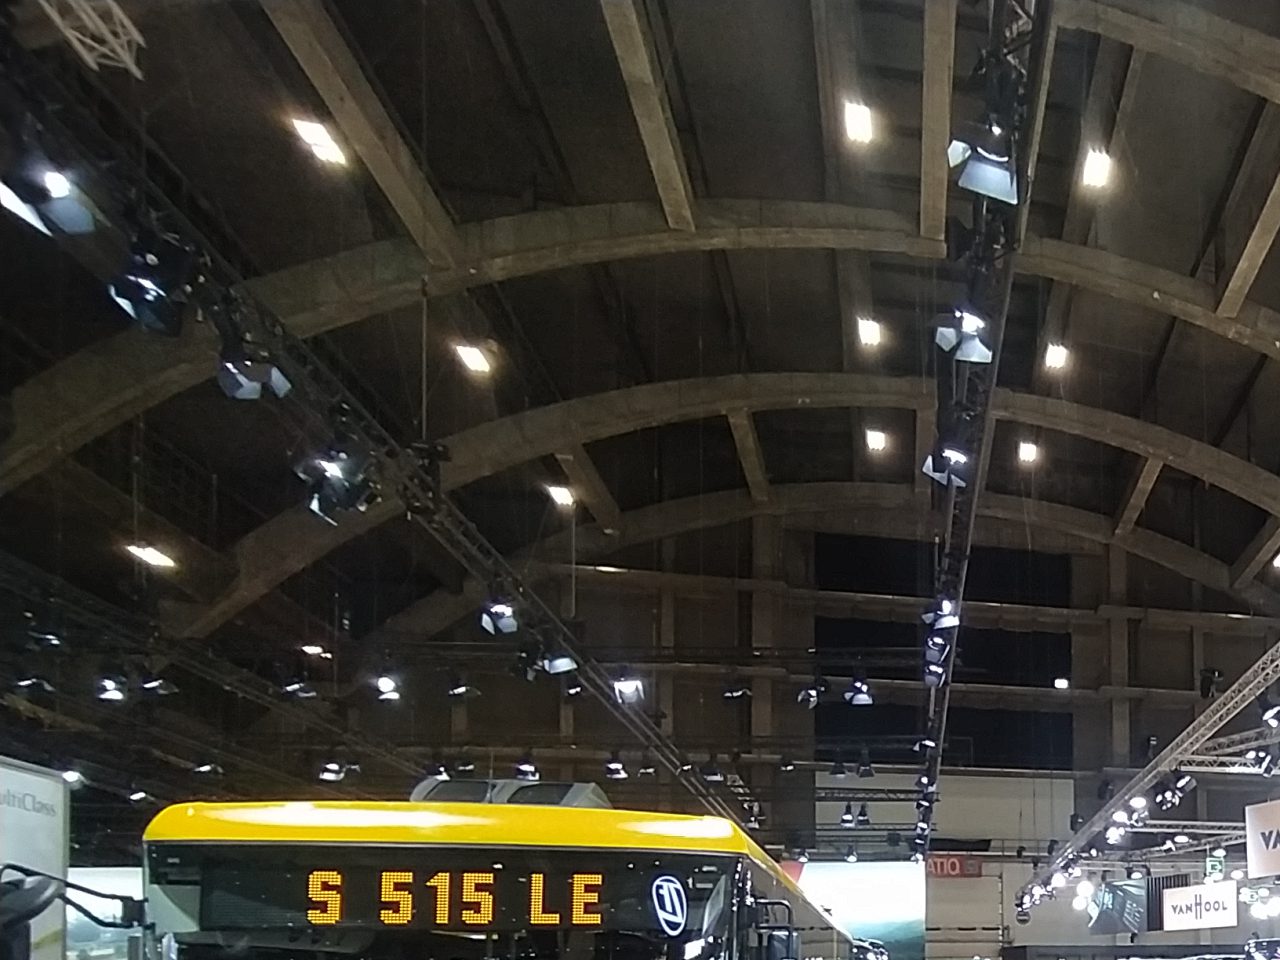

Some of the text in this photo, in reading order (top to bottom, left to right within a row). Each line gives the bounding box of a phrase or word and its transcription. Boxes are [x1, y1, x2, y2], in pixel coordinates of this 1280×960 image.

[306, 870, 603, 925] S 515 LE
